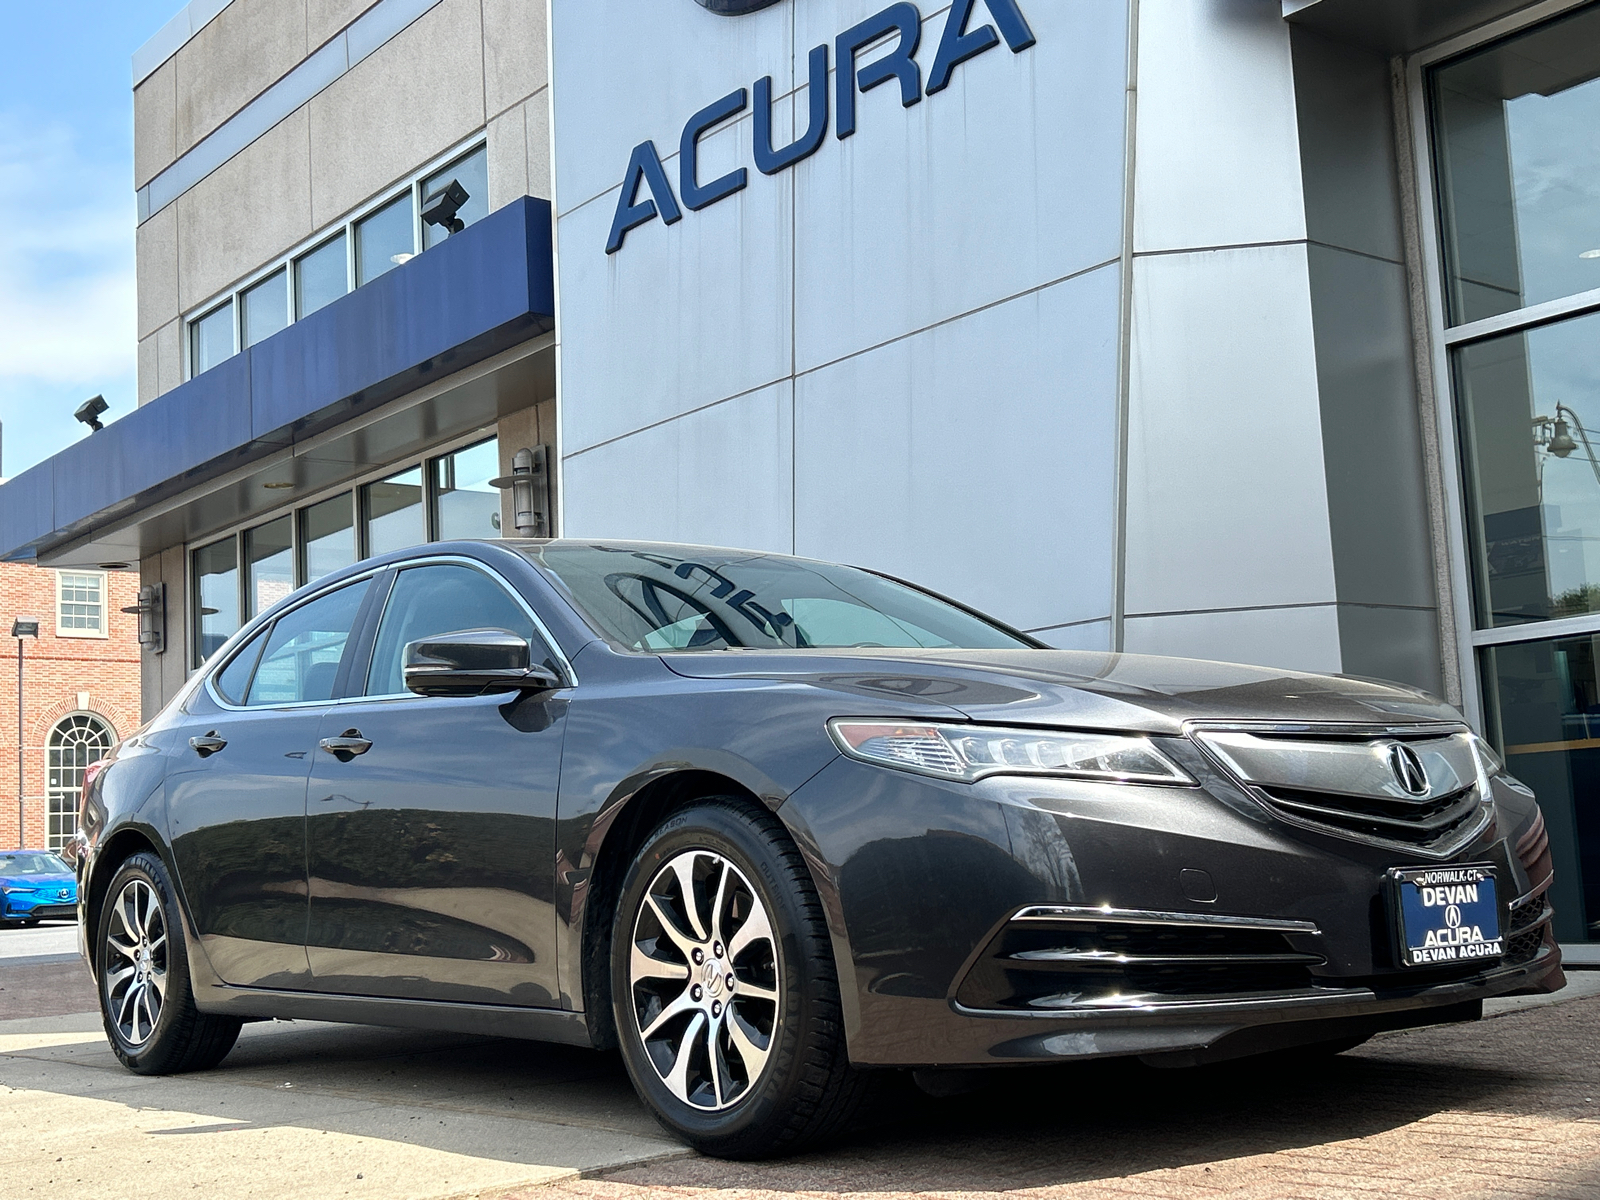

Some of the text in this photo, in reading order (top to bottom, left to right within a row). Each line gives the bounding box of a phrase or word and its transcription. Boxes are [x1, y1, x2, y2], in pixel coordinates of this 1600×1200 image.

[605, 0, 1036, 255] ACURA
[654, 815, 688, 840] SEASON
[759, 861, 788, 912] OUTSIDE
[1467, 869, 1478, 881] CT
[1422, 883, 1478, 907] DEVAN
[1424, 925, 1485, 948] ACURA
[1412, 942, 1502, 963] DEVAN ACURA
